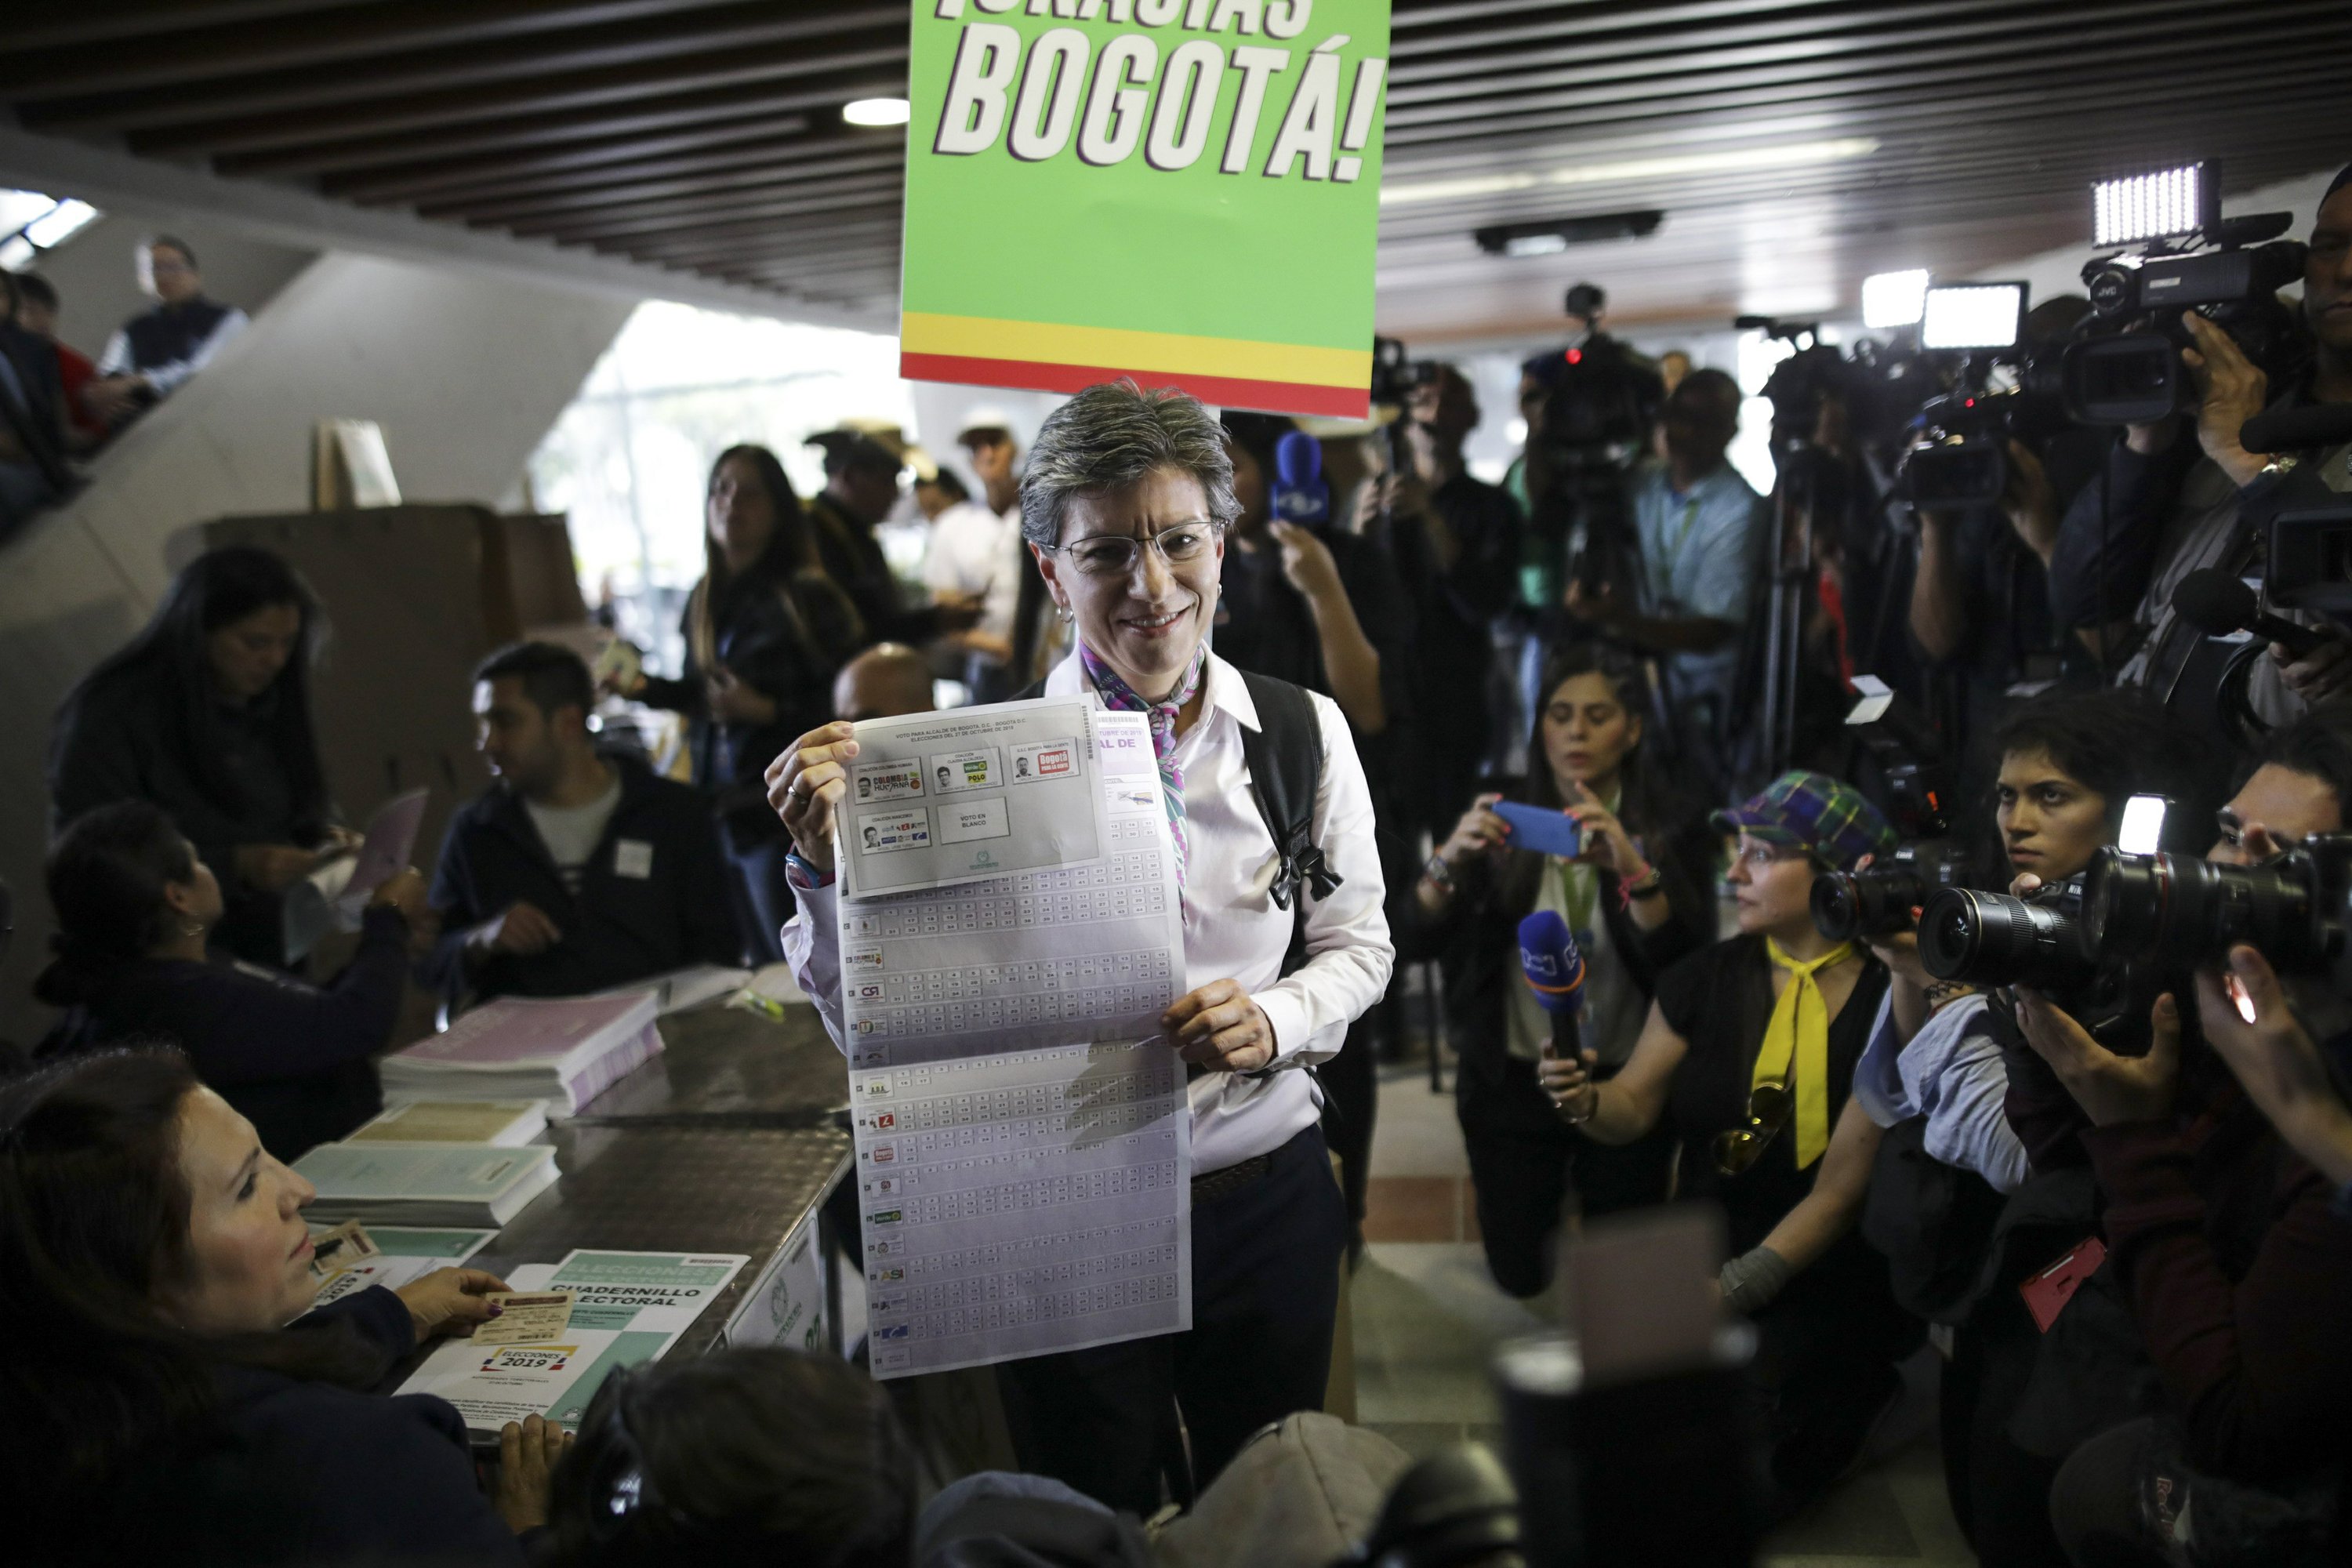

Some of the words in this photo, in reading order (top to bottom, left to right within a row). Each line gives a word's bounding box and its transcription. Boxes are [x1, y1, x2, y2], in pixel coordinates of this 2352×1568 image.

[931, 21, 1388, 183] BOGOTÁ!
[910, 734, 943, 742] ELECCIONES
[1118, 739, 1136, 748] DE
[1040, 751, 1068, 765] Bogotá
[873, 773, 909, 785] COLOMBIA
[573, 1295, 677, 1306] LECTORAL
[502, 1350, 562, 1359] ELECCIONES
[500, 1358, 548, 1368] 2019
